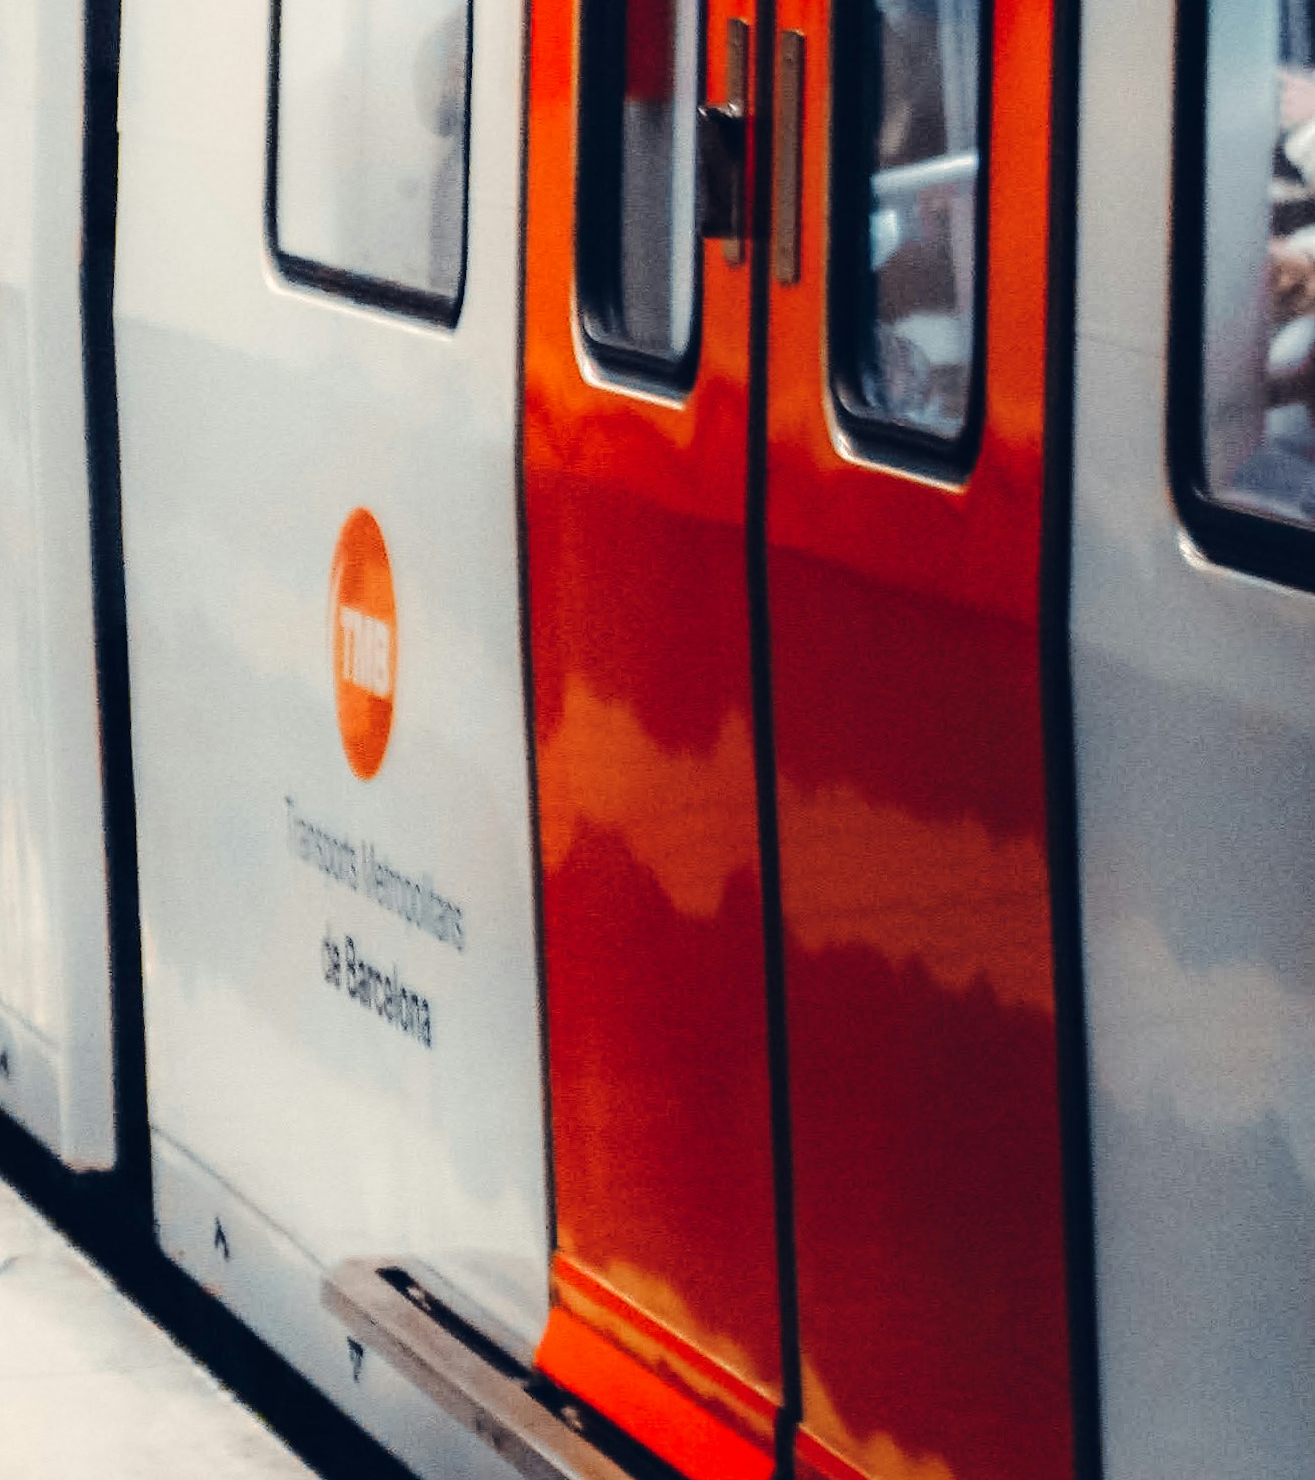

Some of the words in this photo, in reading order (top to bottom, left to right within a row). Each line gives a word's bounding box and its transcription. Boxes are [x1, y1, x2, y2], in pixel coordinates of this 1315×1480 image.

[340, 602, 391, 698] TMB
[321, 926, 341, 990] de
[345, 933, 433, 1050] Barcelona
